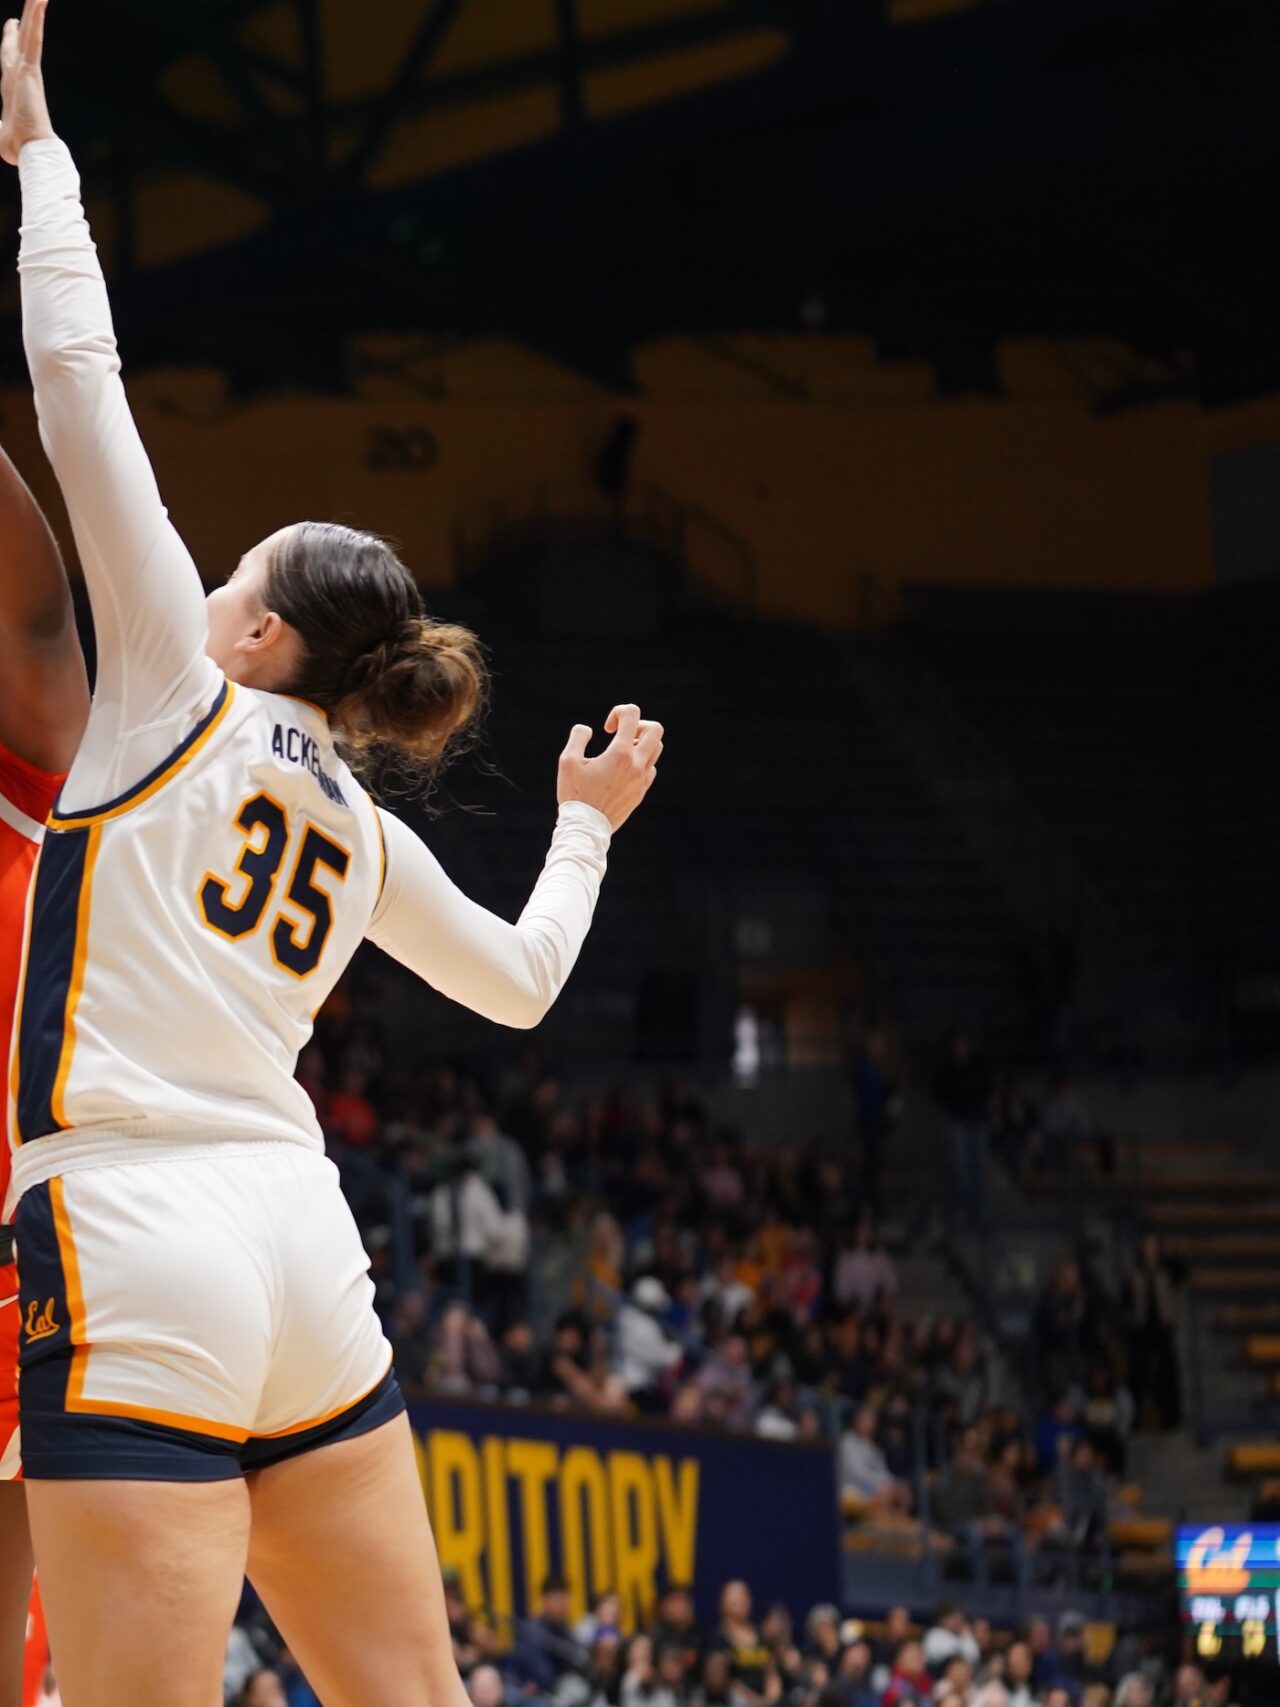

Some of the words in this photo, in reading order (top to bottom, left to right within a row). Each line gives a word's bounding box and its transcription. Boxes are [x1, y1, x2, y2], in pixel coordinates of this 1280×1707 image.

[196, 789, 352, 982] 35
[25, 1298, 60, 1344] Cal
[413, 1428, 699, 1652] RITORY
